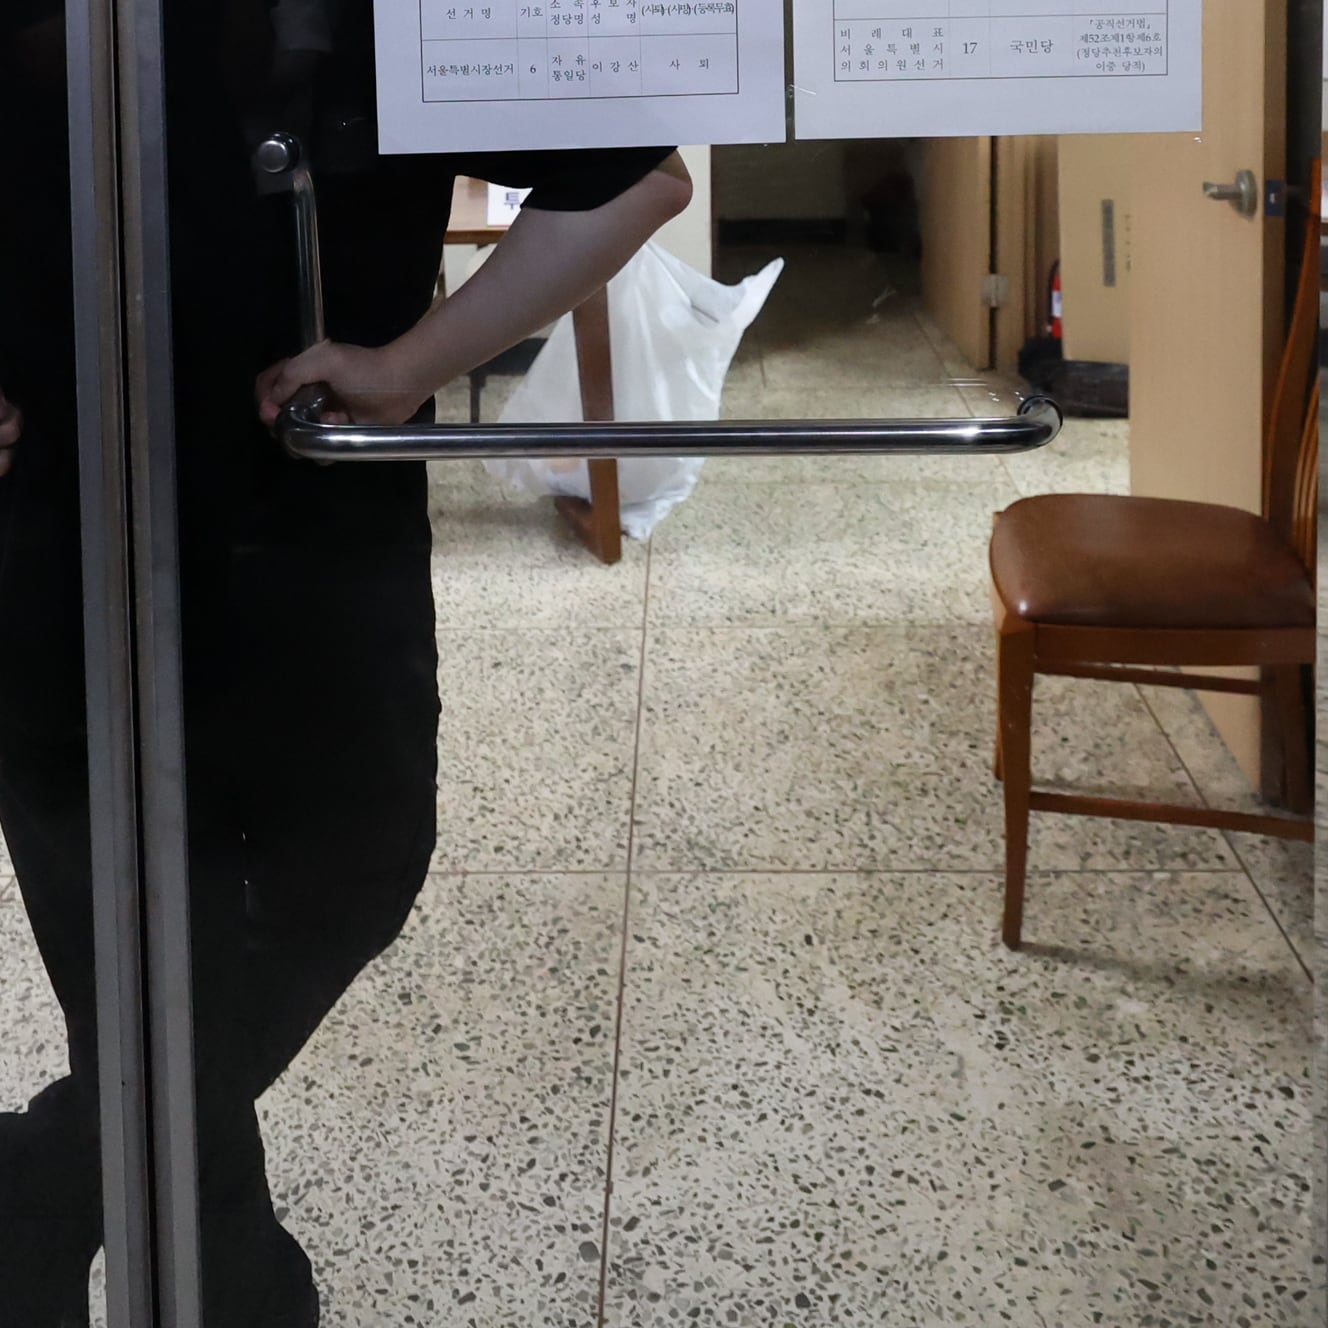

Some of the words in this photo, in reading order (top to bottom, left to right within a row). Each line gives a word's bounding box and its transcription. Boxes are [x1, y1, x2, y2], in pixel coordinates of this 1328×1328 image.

[520, 6, 543, 18] 기호
[551, 13, 583, 25] 정당명
[963, 42, 978, 54] 17
[1010, 40, 1054, 54] 국민당
[427, 64, 513, 76] 서울특별시장선거
[530, 65, 536, 73] 6
[552, 70, 586, 81] 통일당
